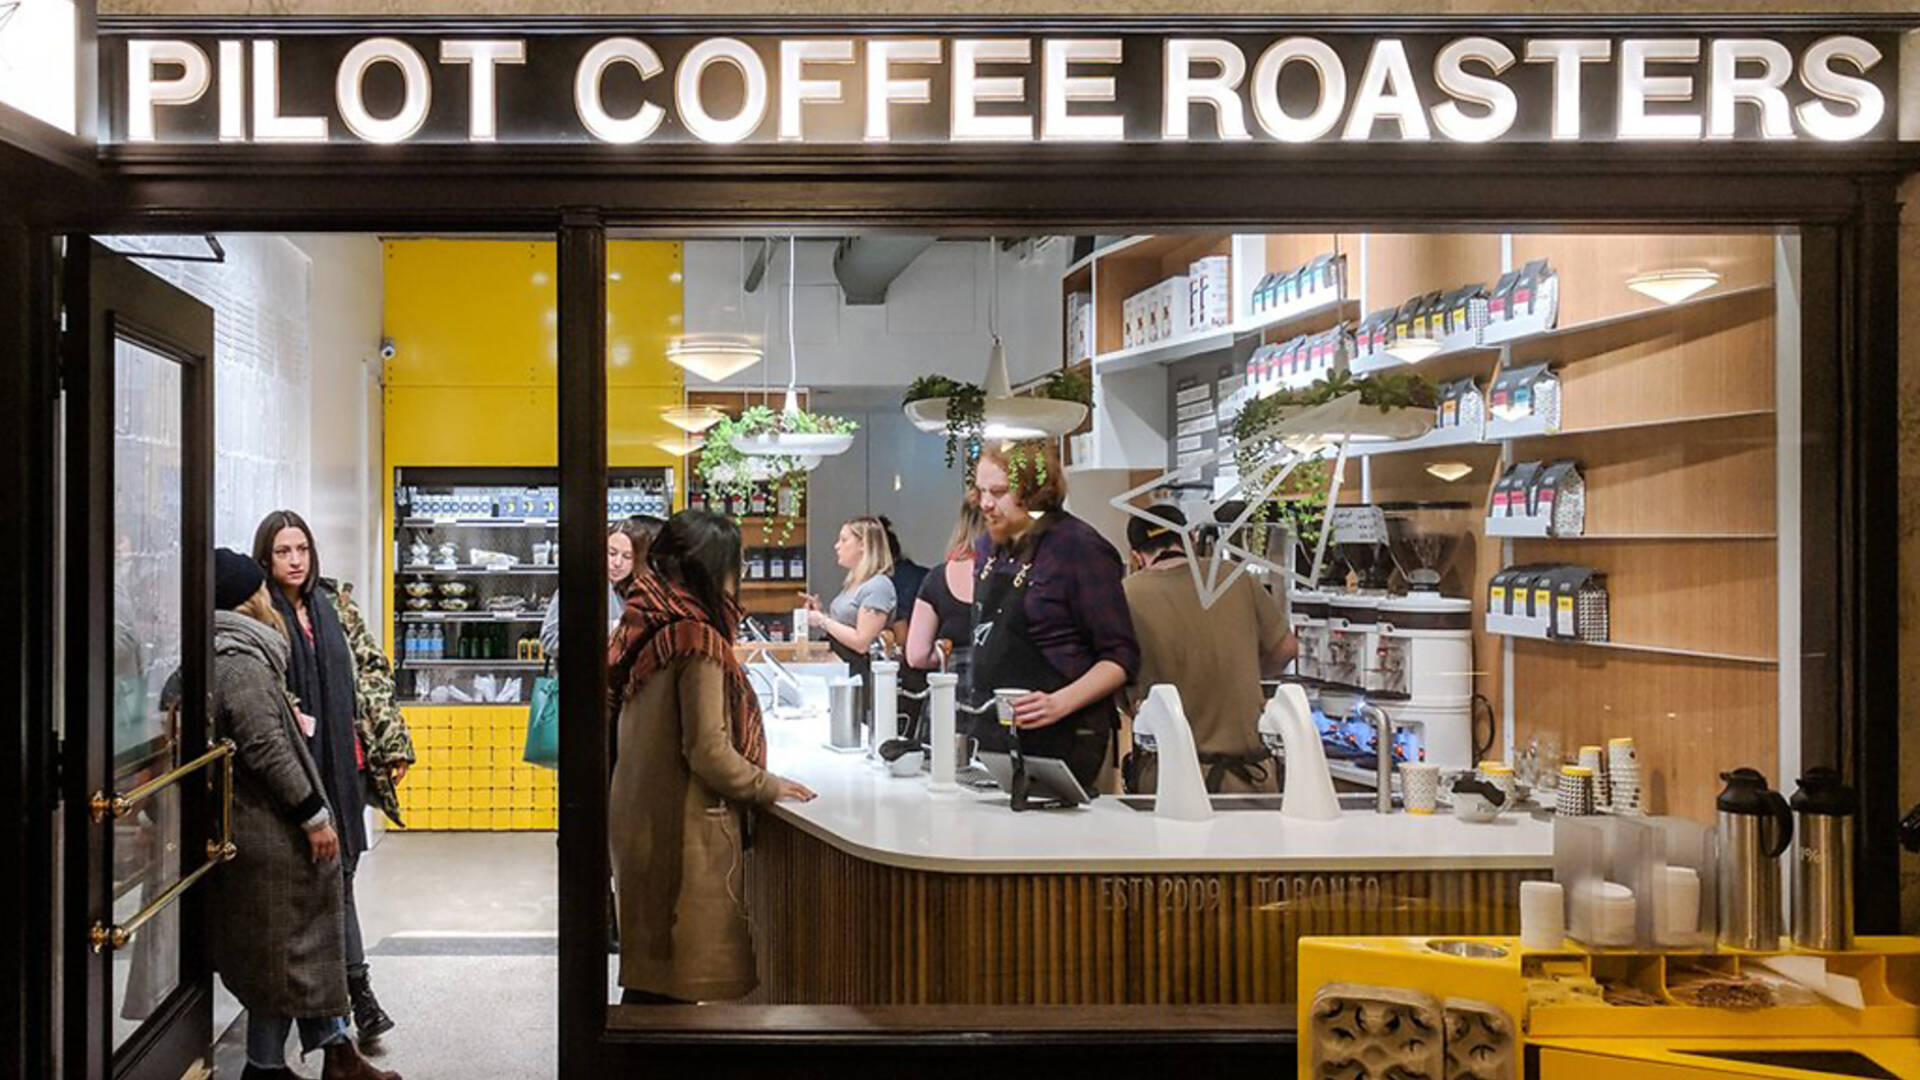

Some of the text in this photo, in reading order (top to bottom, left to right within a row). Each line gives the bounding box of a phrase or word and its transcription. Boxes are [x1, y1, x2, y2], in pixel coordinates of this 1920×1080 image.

[127, 36, 1886, 144] PILOT COFFEE ROASTERS
[1158, 876, 1221, 911] 2009
[1256, 875, 1381, 910] TORONTO
